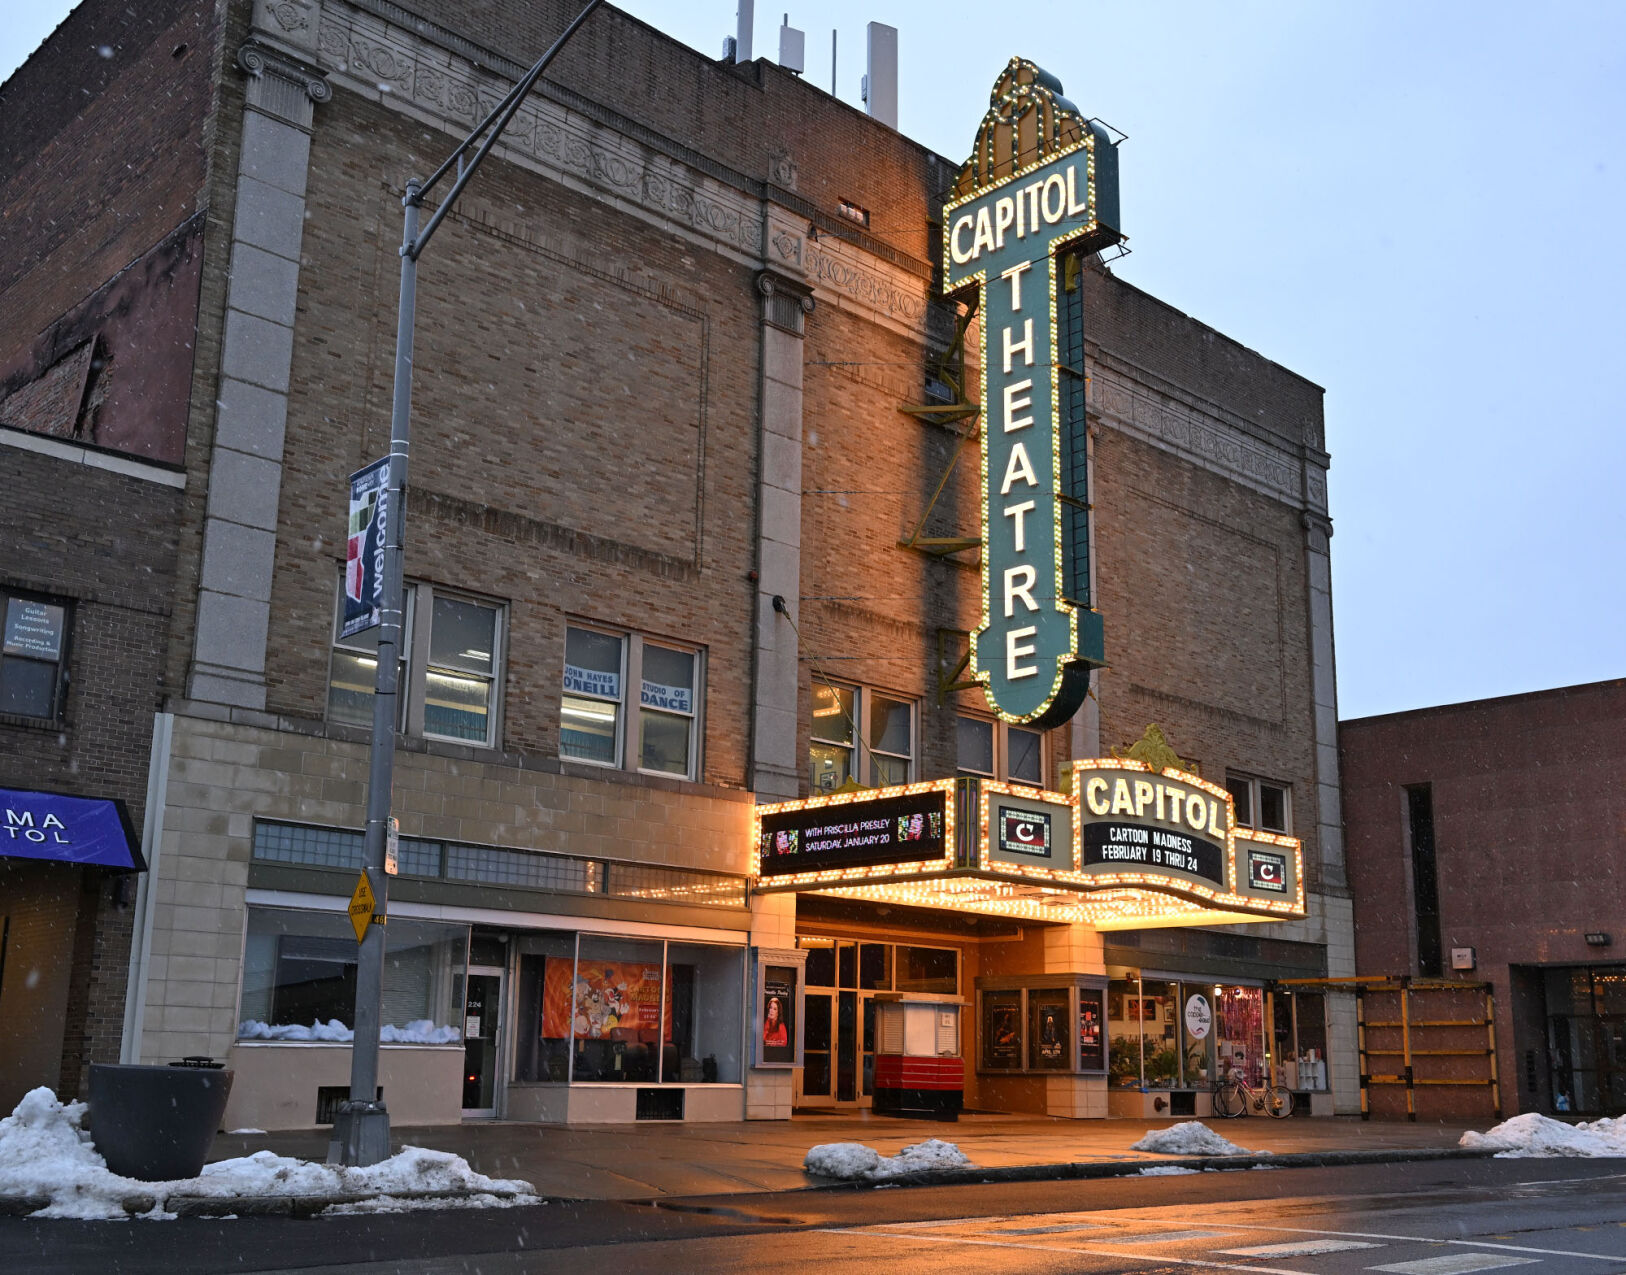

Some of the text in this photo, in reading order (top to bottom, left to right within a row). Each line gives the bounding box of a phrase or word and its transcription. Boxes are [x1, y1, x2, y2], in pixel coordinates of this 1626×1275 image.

[951, 165, 1086, 265] CAPITOL
[1000, 260, 1040, 680] THEATRE
[372, 463, 390, 599] welcome
[21, 614, 49, 624] Lessons
[25, 608, 47, 616] Guitar
[14, 623, 54, 636] Songwriting
[25, 643, 58, 653] Production
[565, 666, 613, 683] JOHN HAYES
[642, 682, 685, 699] STUDIO OF
[641, 691, 689, 711] DANCE
[1086, 777, 1226, 840] CAPITOL
[805, 819, 890, 838] WITH PRISCILLA PRESLEY
[843, 835, 879, 847] JANUARY
[880, 833, 890, 844] 20
[1109, 827, 1192, 854] CARTOON MADNESS
[1102, 845, 1198, 872] FEBRUARY 19 THRU 24
